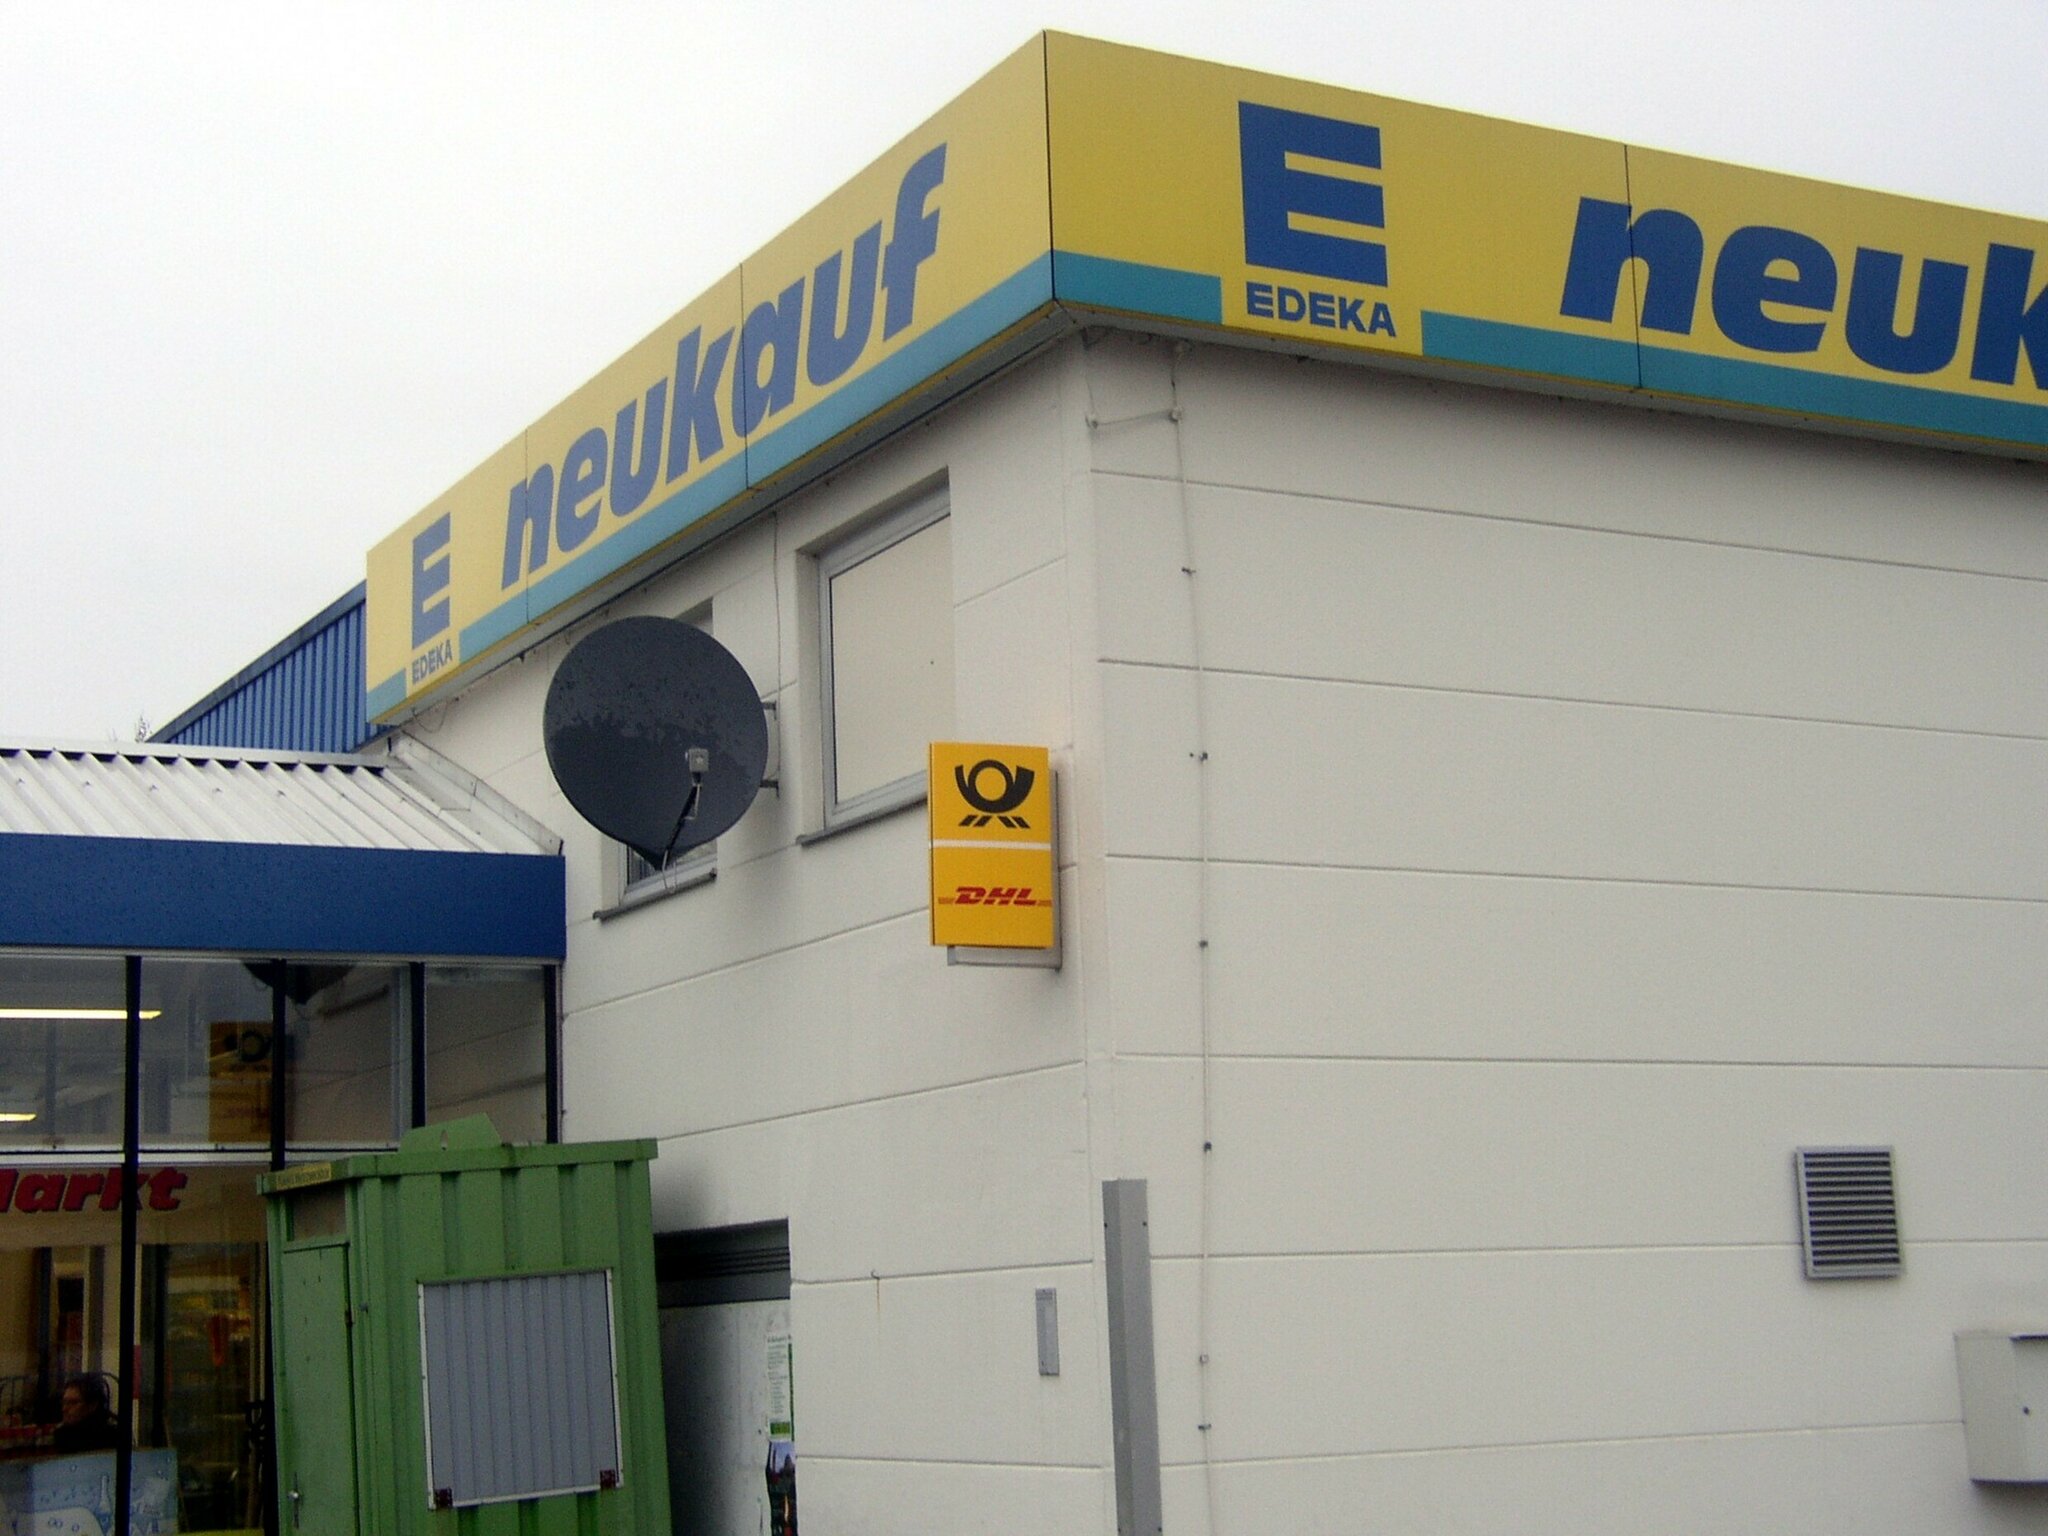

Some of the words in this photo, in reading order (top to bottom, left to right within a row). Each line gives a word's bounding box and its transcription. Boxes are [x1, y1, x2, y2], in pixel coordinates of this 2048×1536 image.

[1238, 101, 1388, 287] E
[1246, 282, 1397, 338] EDEKA
[501, 142, 948, 591] neukauf
[412, 512, 451, 650] E
[412, 639, 453, 685] EDEKA
[956, 887, 1036, 905] DHL
